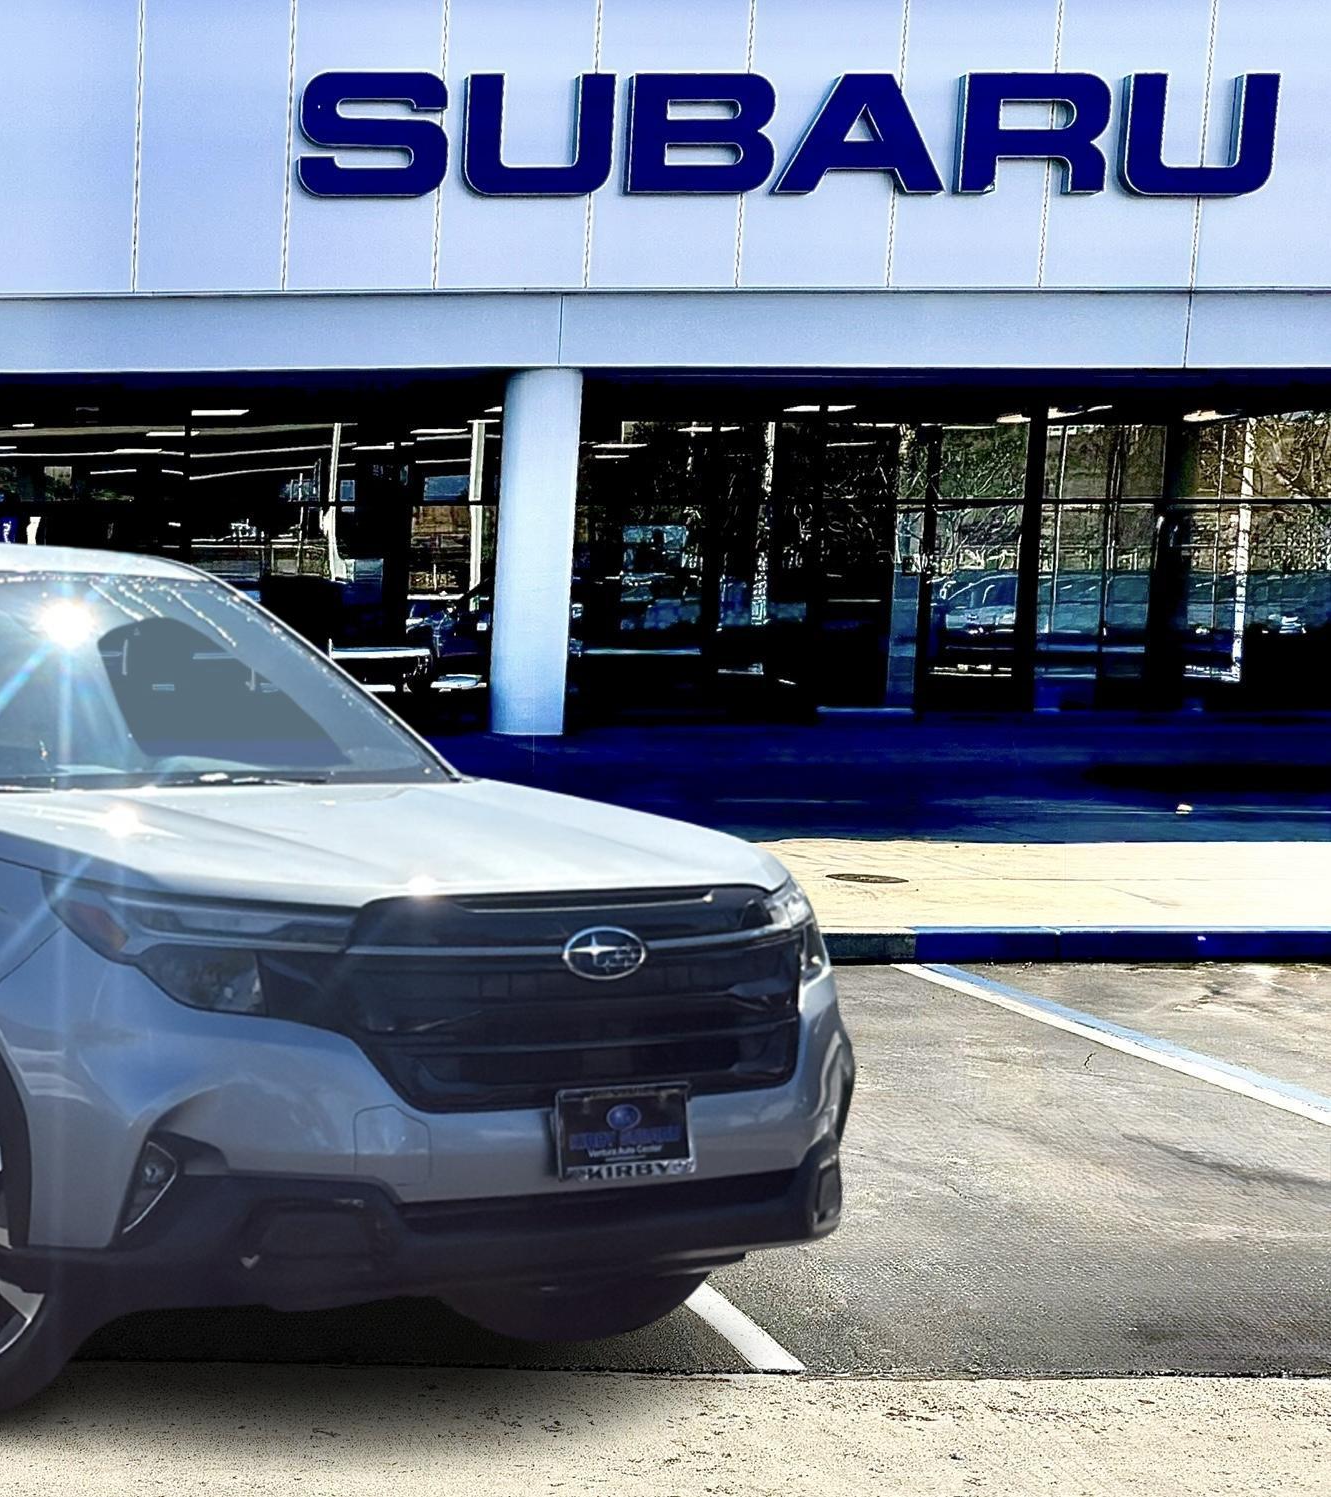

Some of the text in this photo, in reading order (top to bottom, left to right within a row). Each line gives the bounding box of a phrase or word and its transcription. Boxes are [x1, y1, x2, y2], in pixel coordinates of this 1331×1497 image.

[296, 69, 1282, 198] SUBARU
[588, 1147, 617, 1158] Ventura
[618, 1146, 636, 1155] Auto
[636, 1144, 663, 1153] Center
[587, 1162, 671, 1179] KIRBY
